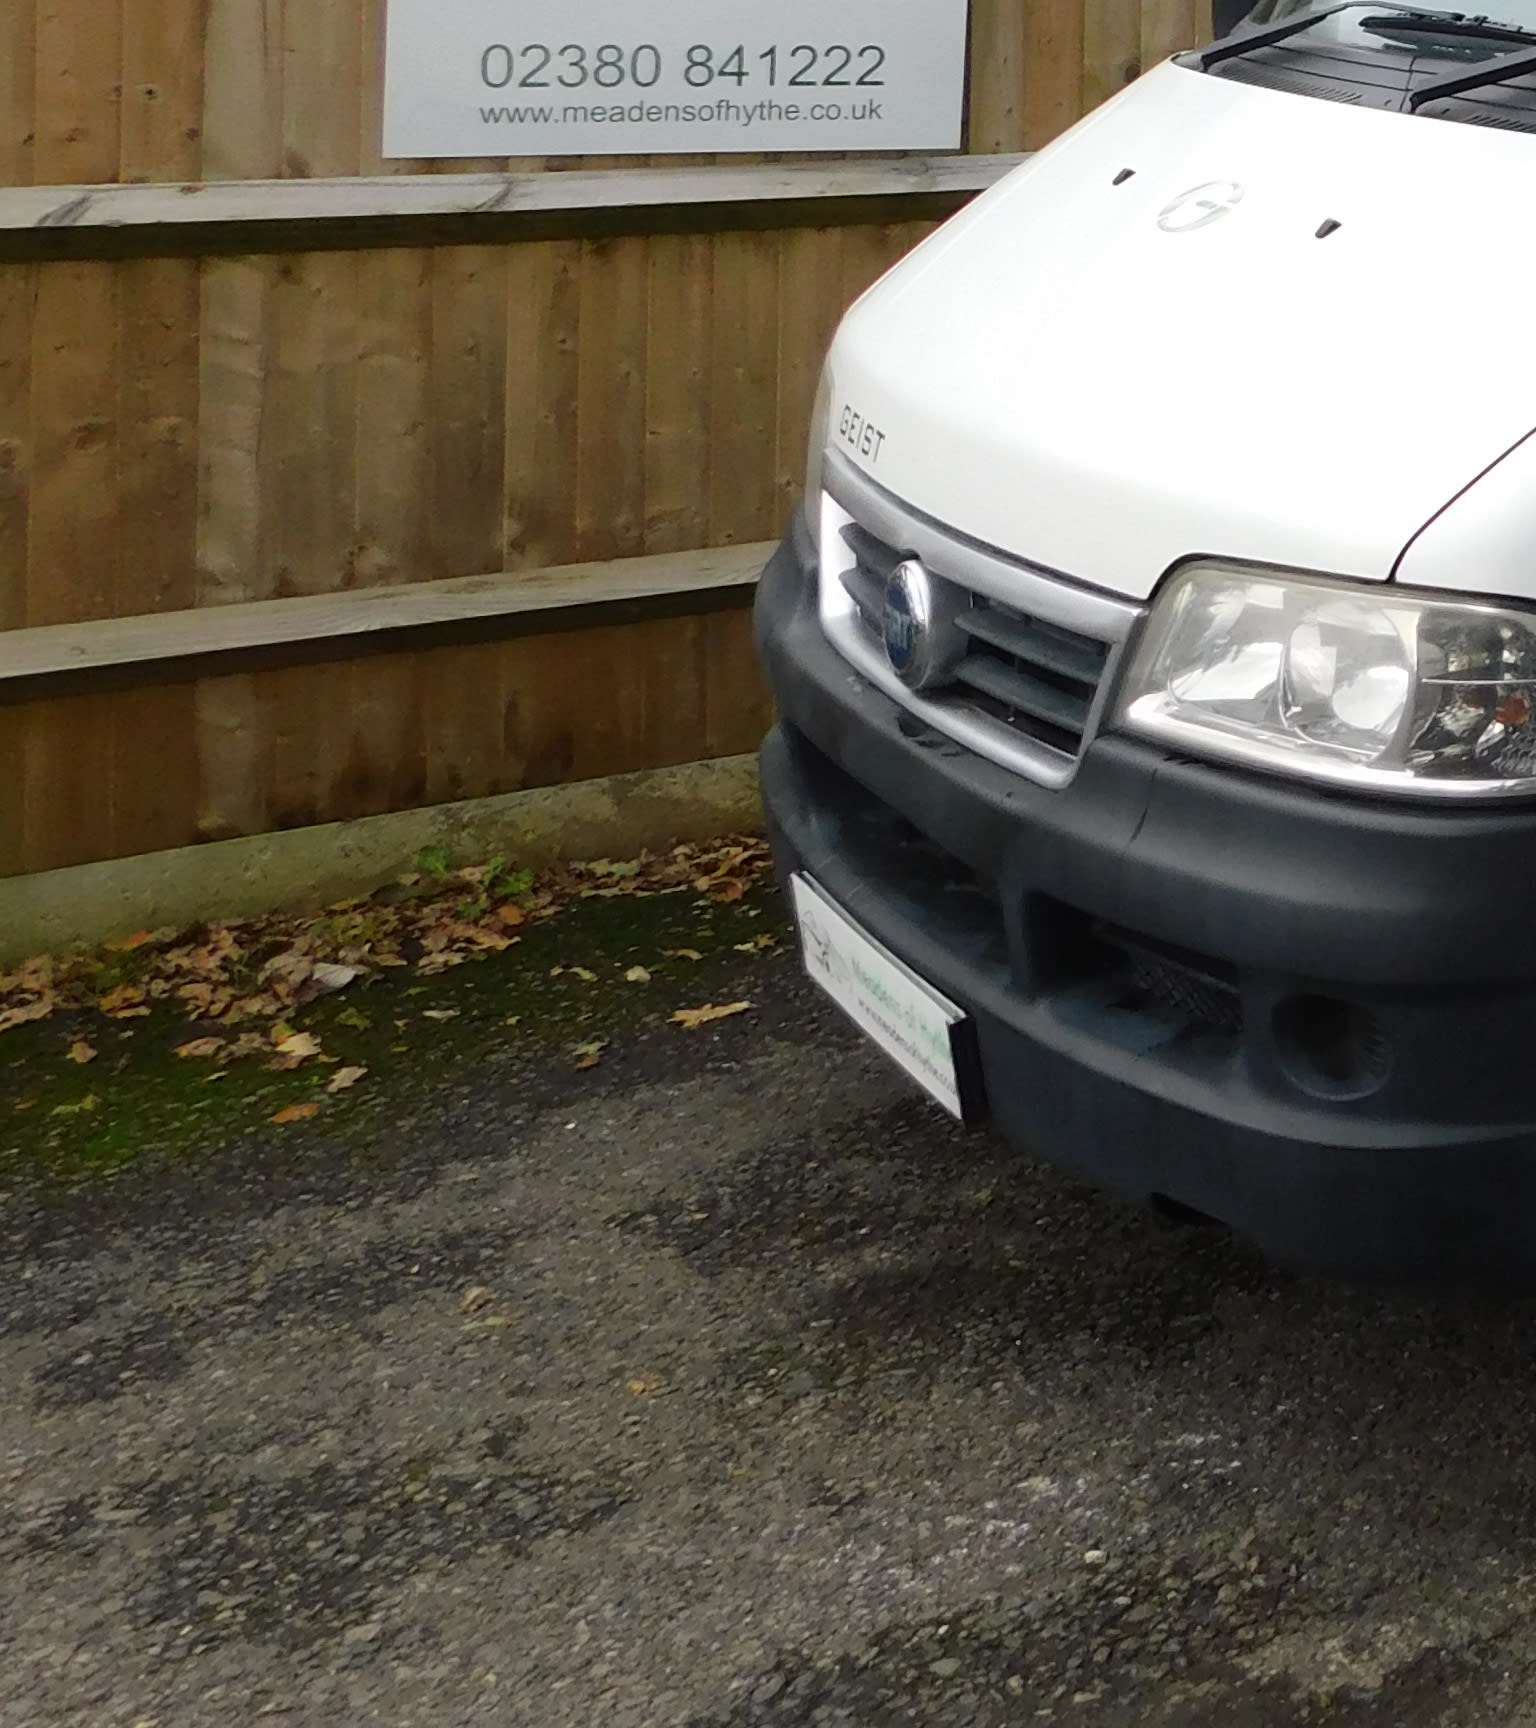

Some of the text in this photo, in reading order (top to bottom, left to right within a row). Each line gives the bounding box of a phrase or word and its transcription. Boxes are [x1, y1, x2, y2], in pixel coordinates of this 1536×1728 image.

[480, 43, 887, 89] 02380 841222
[480, 98, 883, 127] www.meadensofhythe.co.uk
[839, 404, 886, 463] GEIST
